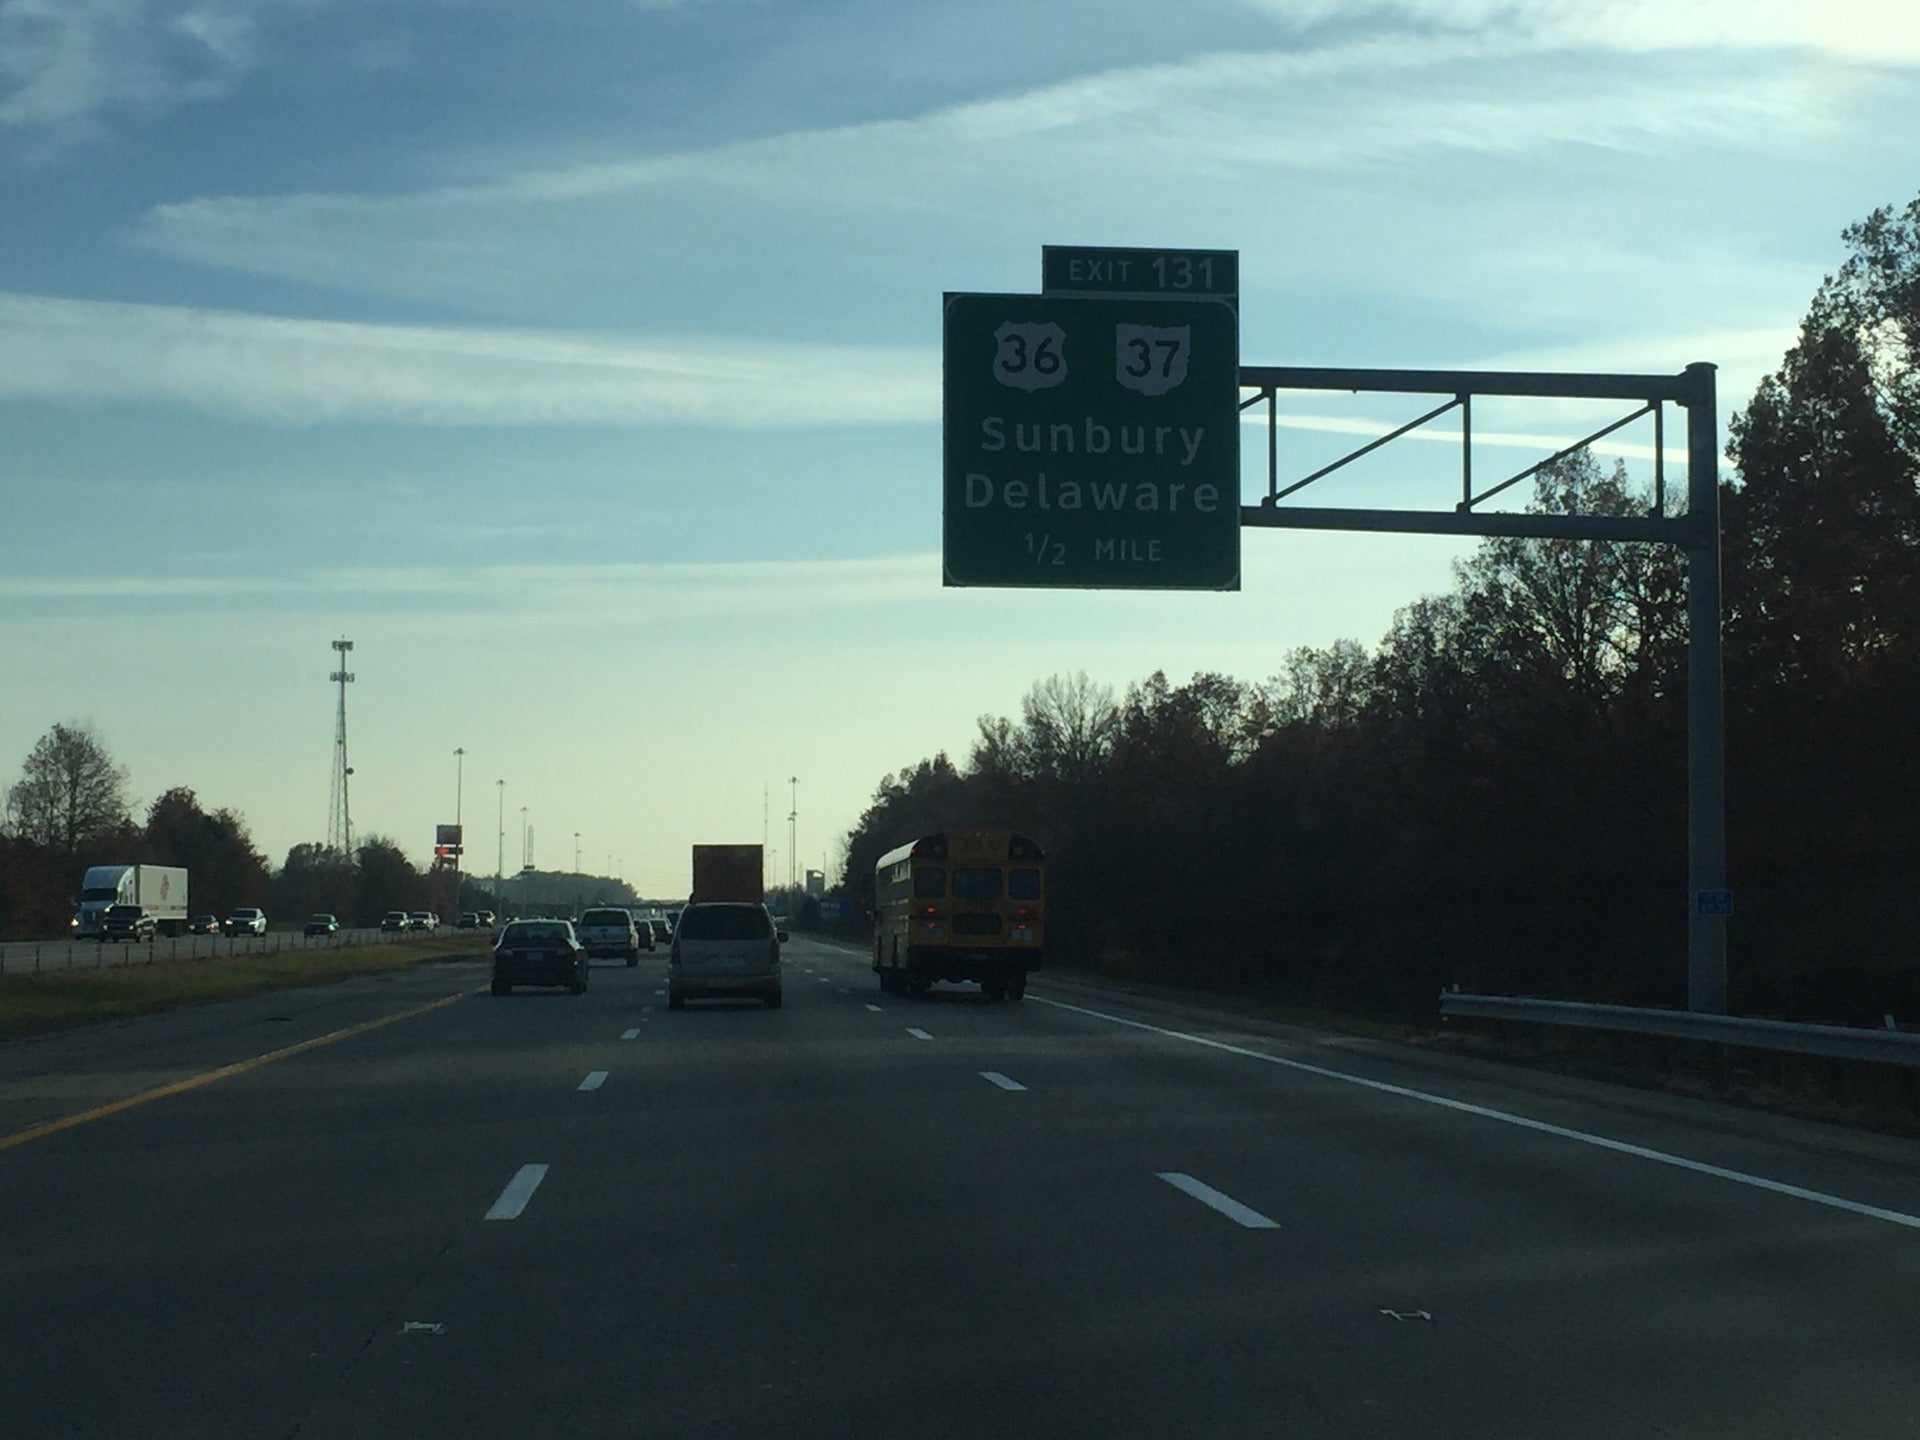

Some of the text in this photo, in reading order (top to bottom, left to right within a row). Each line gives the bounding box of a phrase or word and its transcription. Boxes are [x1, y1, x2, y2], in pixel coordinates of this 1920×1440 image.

[1069, 257, 1213, 289] EXIT 131
[1001, 334, 1060, 375] 36
[1126, 338, 1180, 378] 37
[982, 417, 1204, 466] Sunbury
[966, 474, 1219, 512] Delaware
[1095, 539, 1163, 562] MILE
